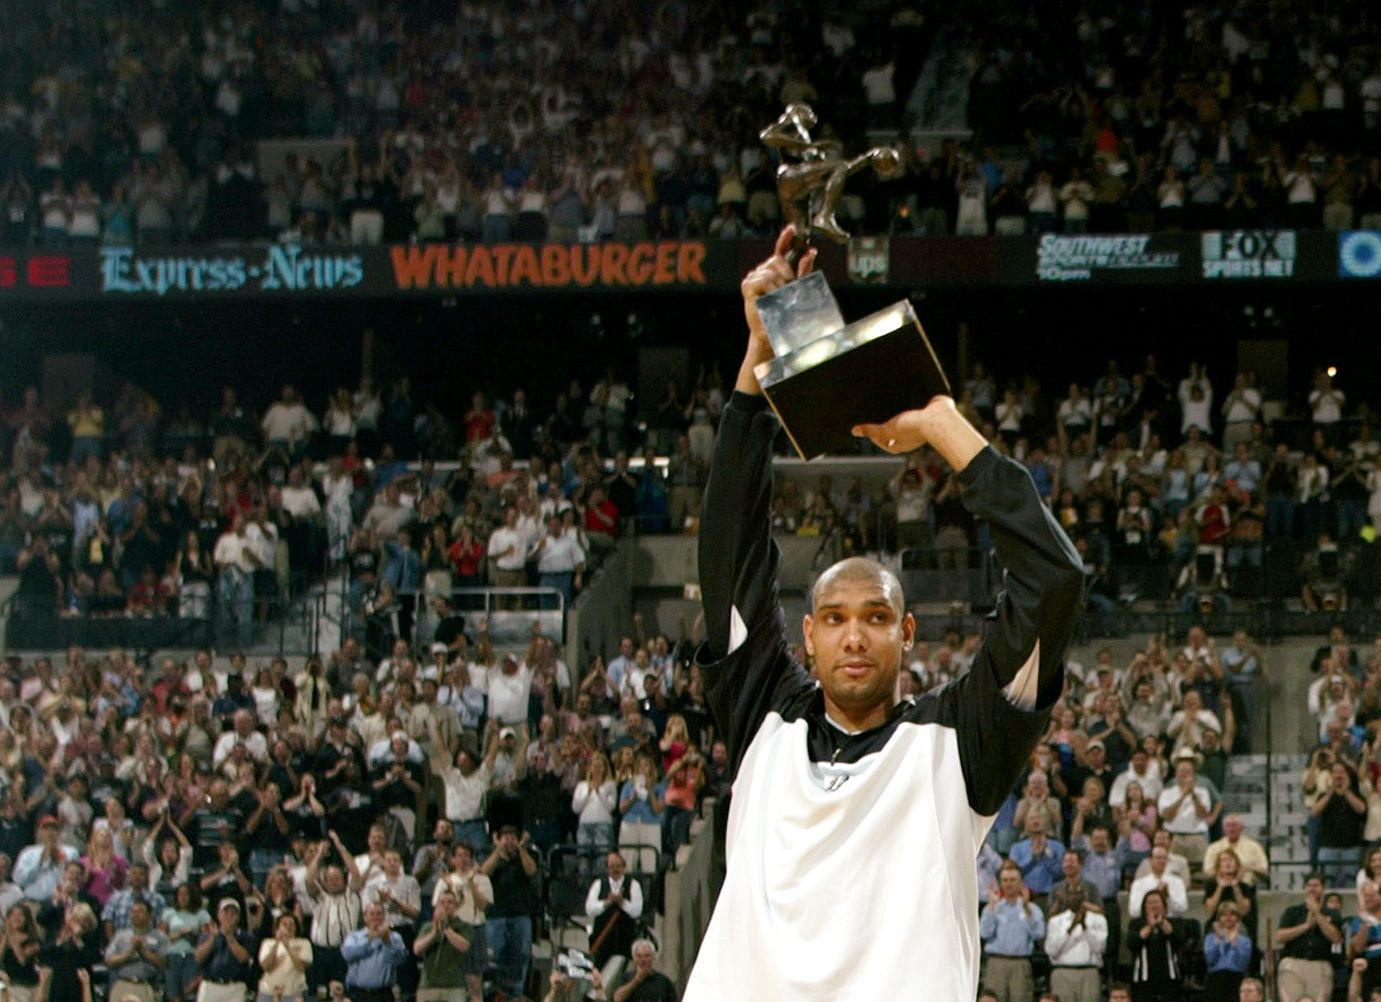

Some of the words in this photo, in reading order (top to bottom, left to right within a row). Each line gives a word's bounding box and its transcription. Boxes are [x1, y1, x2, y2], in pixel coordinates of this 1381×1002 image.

[1220, 231, 1280, 259] FOX
[101, 246, 364, 294] Express-News
[390, 242, 706, 288] WHATABURGER
[849, 255, 889, 278] ups
[1202, 259, 1261, 277] SPORTS
[1264, 259, 1294, 277] NET
